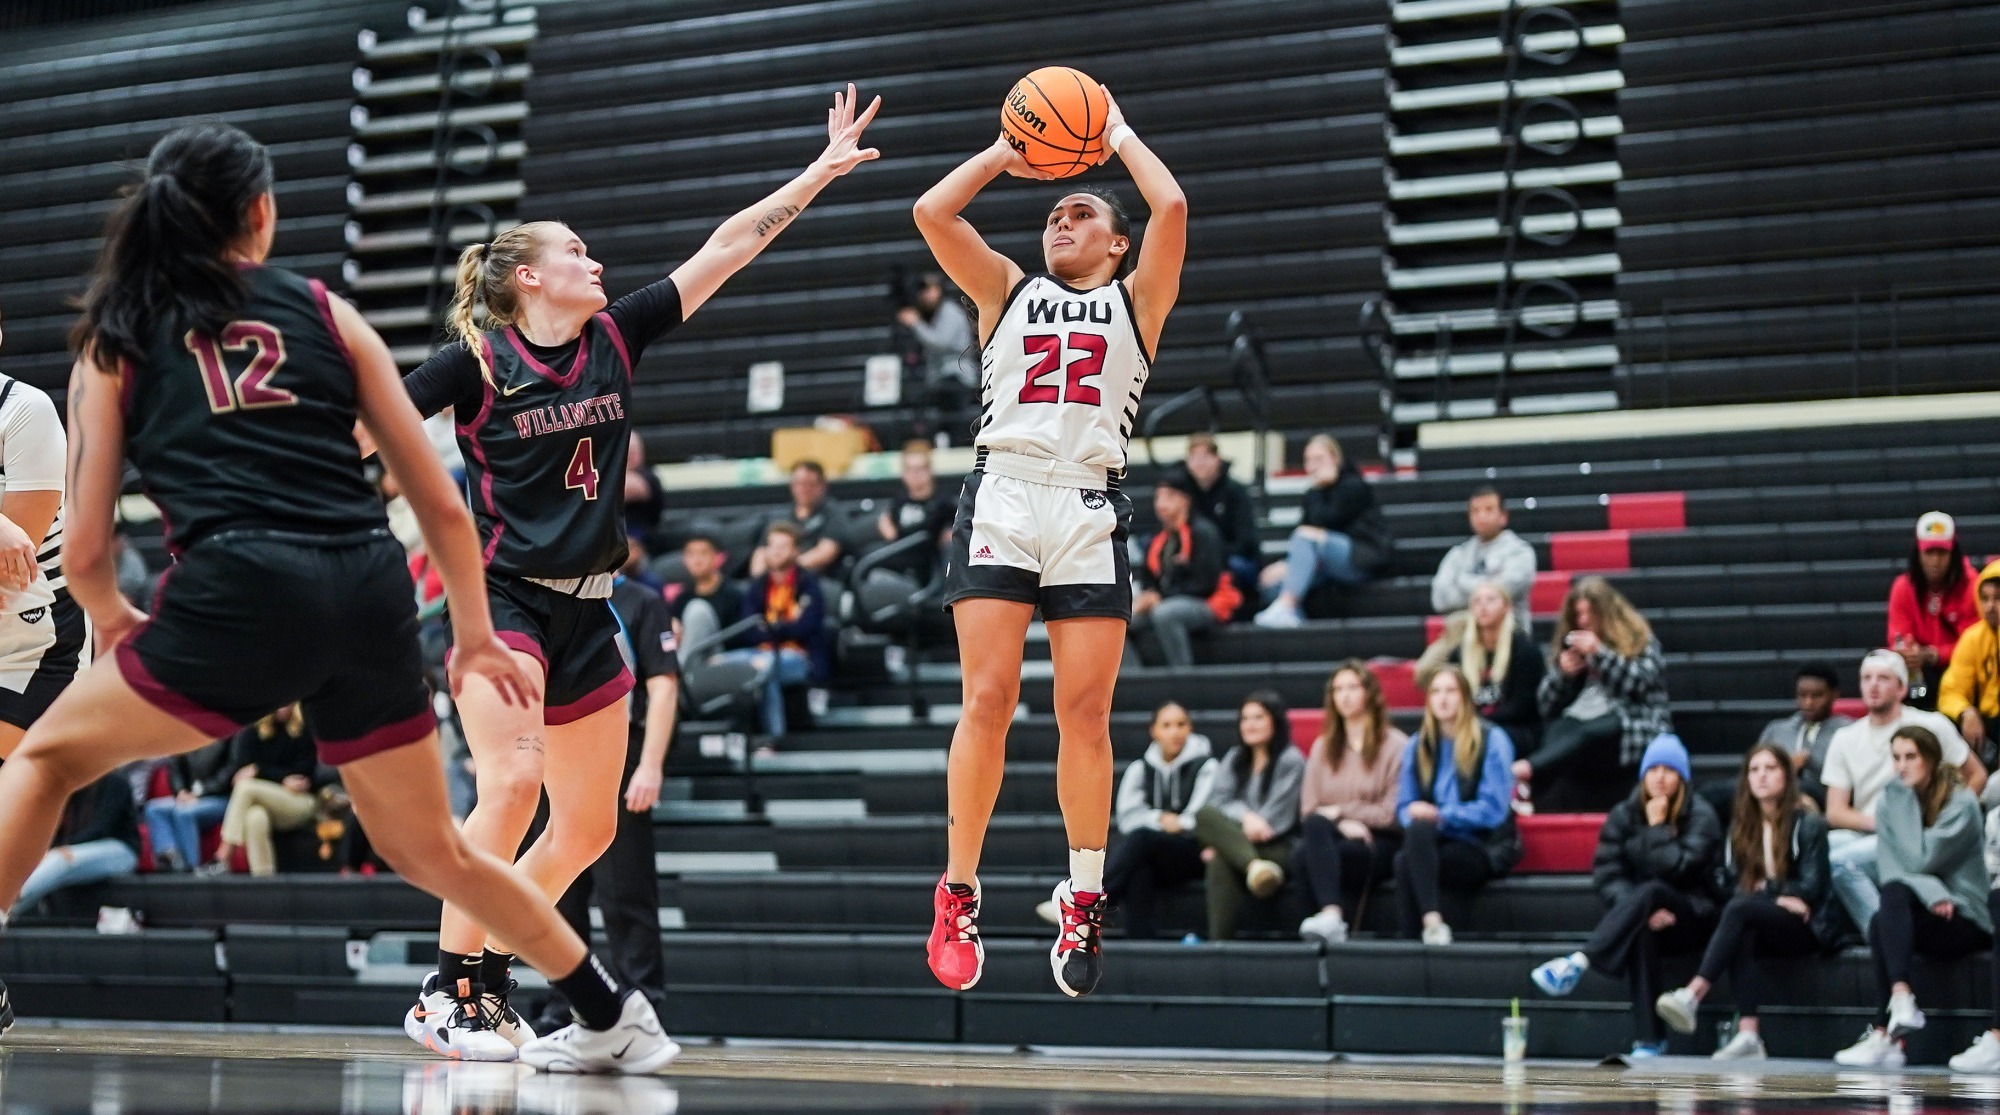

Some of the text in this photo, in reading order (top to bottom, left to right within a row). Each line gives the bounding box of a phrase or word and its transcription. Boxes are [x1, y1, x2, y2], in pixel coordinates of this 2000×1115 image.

[1001, 124, 1027, 155] CAA
[1027, 297, 1112, 325] WOU
[184, 320, 299, 415] 12
[1018, 331, 1108, 407] 22
[513, 392, 625, 439] WILLAMETTE
[565, 437, 600, 501] 4
